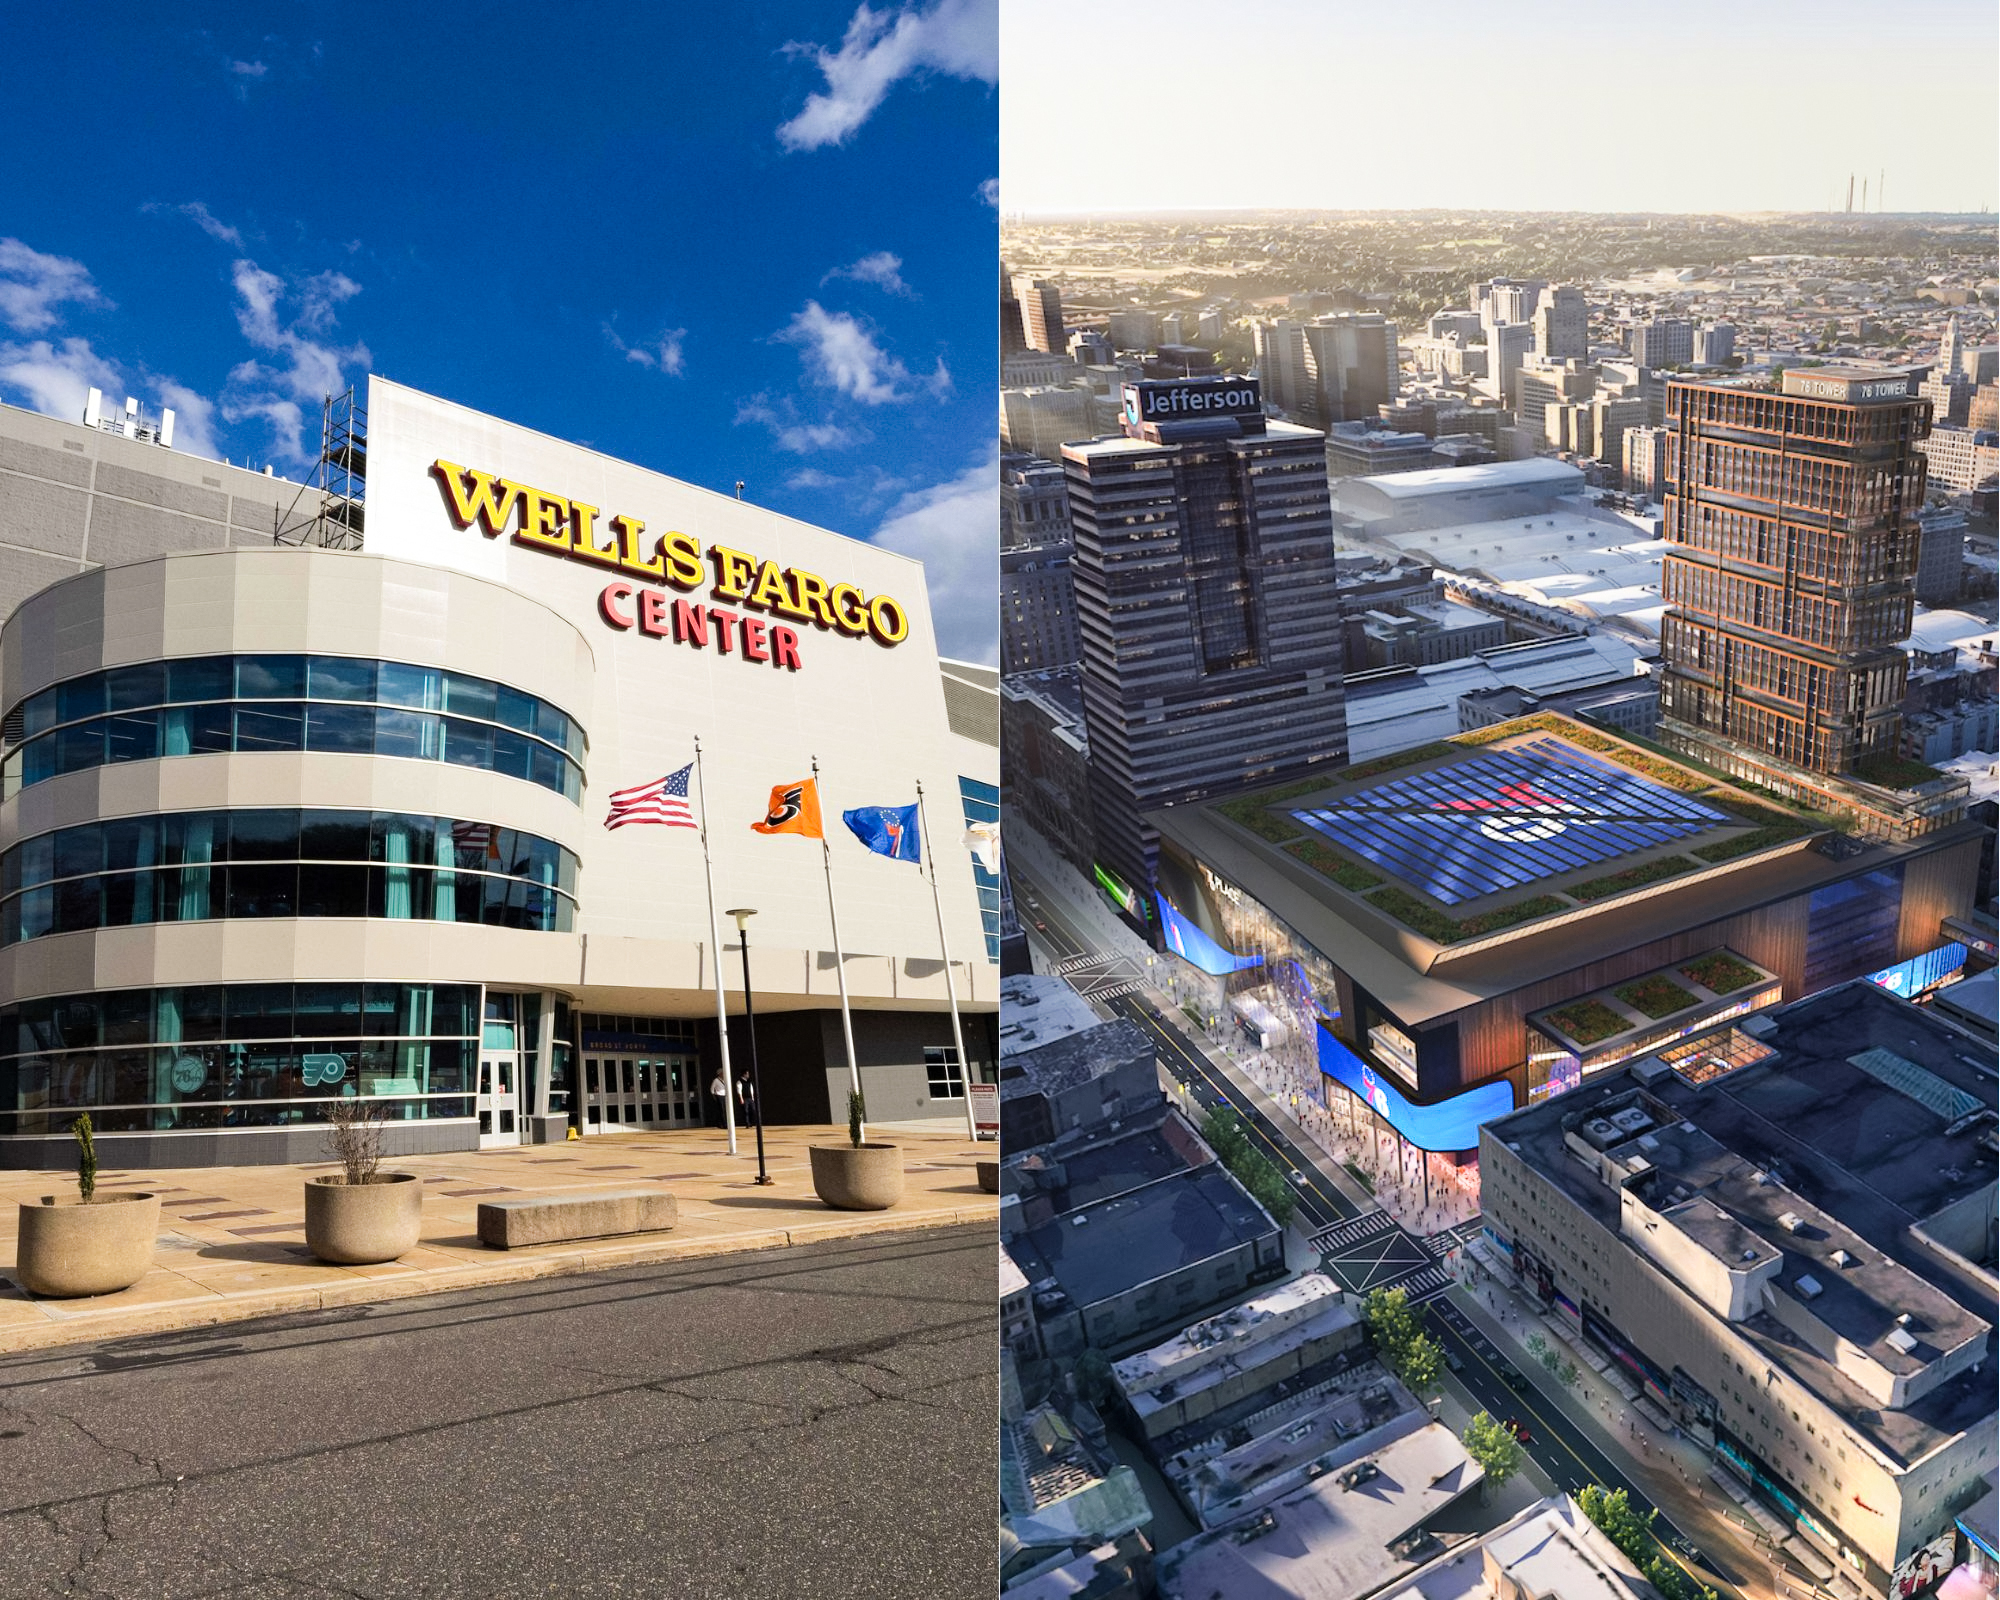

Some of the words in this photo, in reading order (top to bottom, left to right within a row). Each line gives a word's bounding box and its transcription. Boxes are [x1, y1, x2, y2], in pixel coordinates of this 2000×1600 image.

[1146, 388, 1255, 414] Jefferson
[1800, 380, 1812, 393] 76
[1813, 381, 1847, 399] TOWER
[1861, 385, 1873, 399] 76
[1874, 381, 1908, 398] TOWER
[432, 458, 706, 590] WELLS
[709, 543, 909, 648] FARGO
[600, 581, 803, 670] CENTER
